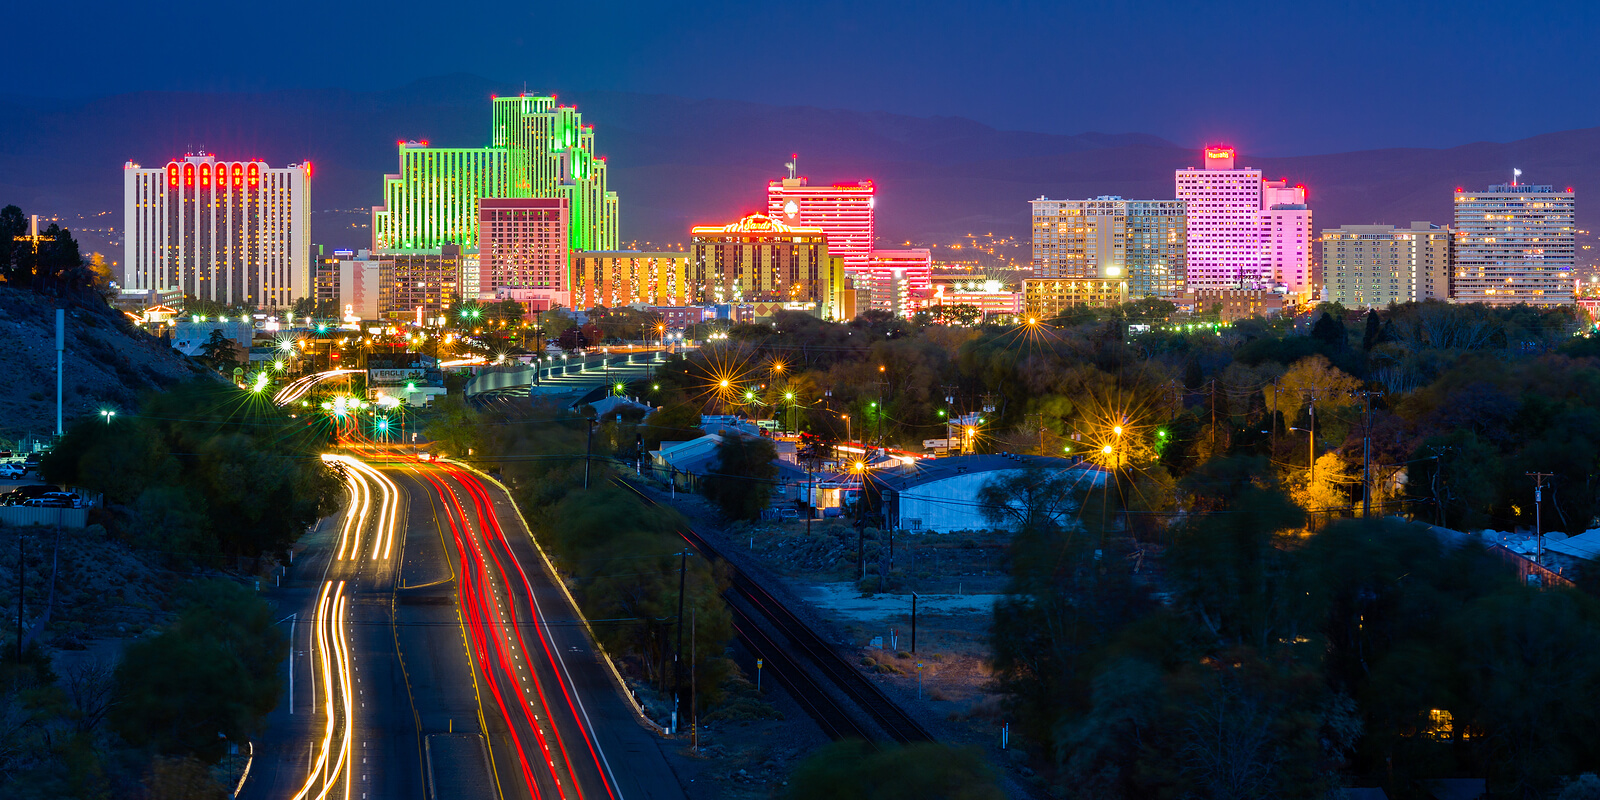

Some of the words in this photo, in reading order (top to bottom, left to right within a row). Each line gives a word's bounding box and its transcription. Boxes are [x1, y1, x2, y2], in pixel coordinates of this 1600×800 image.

[171, 168, 256, 176] CIRCUS
[171, 177, 256, 185] CIRCUS
[743, 218, 772, 230] Sands
[380, 369, 405, 377] EAGLE
